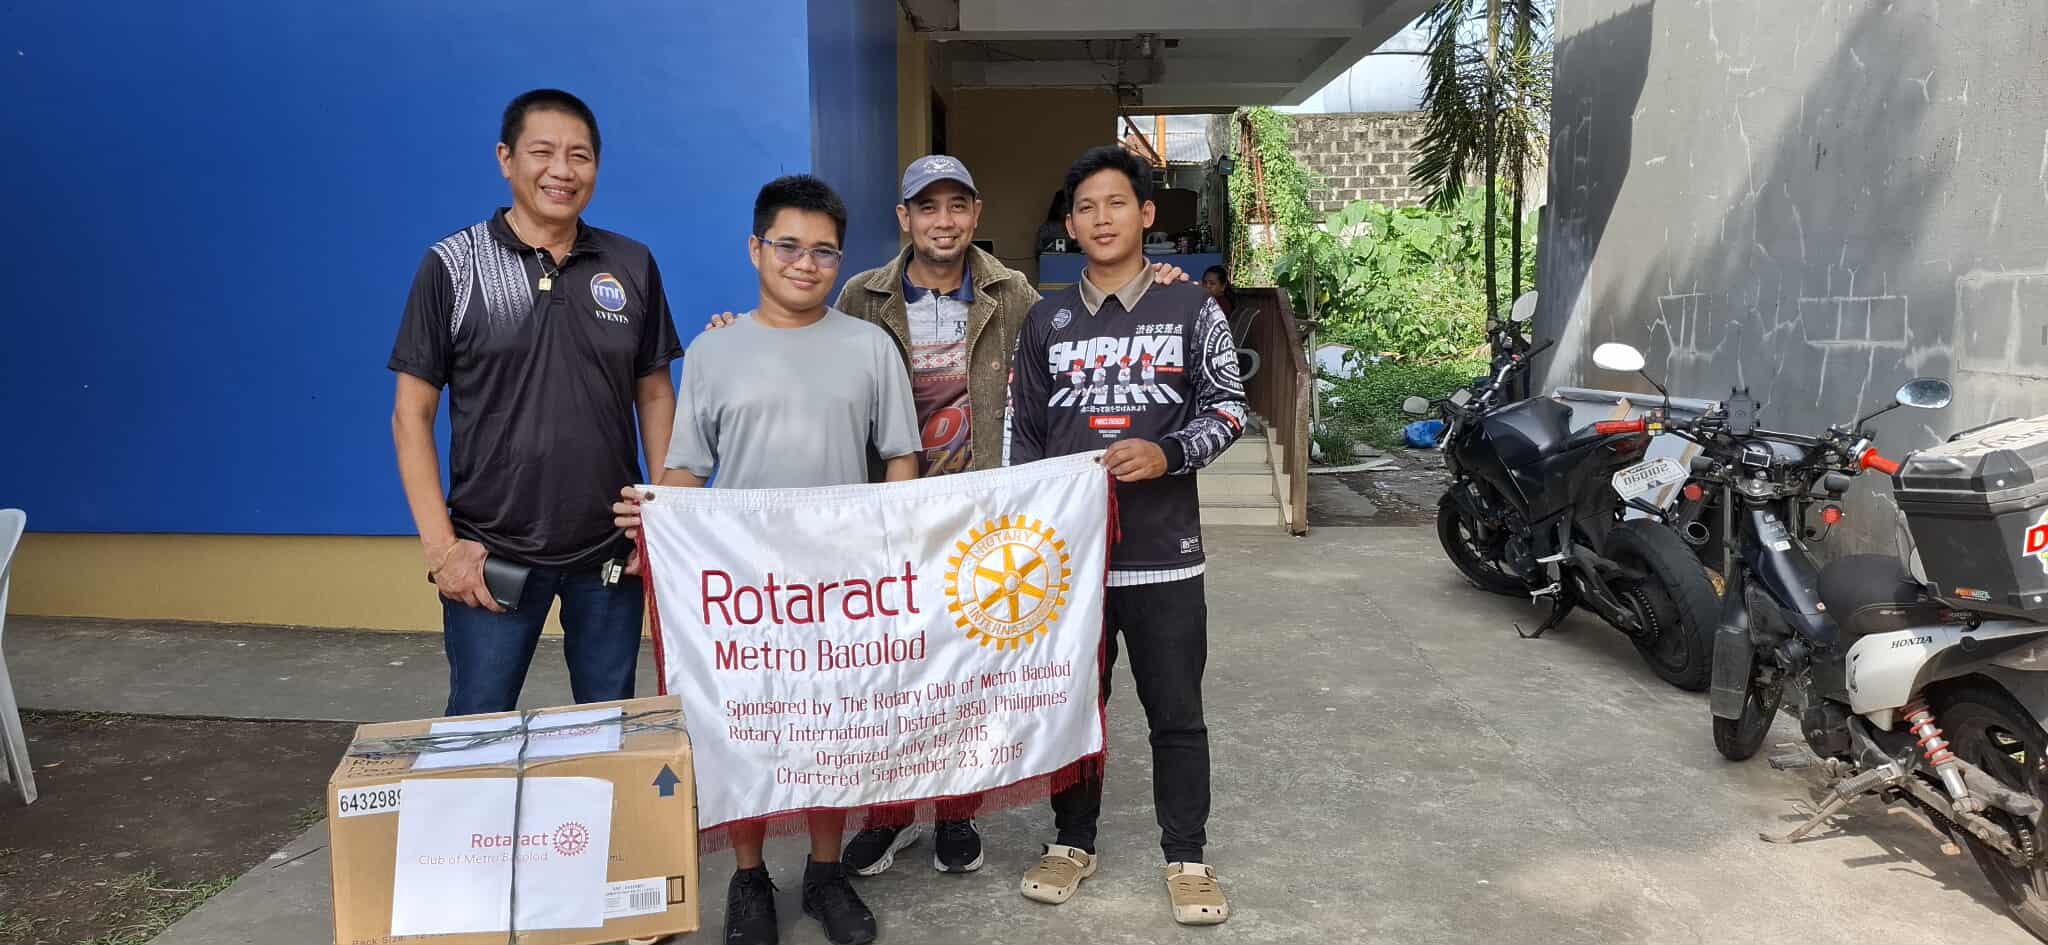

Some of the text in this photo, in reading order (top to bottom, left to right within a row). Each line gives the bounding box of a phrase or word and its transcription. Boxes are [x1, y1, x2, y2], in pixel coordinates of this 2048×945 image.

[1047, 335, 1184, 374] SHIBUYA
[701, 561, 920, 626] Rotaract
[966, 598, 1056, 637] INTERNAT
[715, 630, 925, 672] Metro Bacolod
[1891, 635, 1933, 649] HONDA
[726, 659, 1072, 721] Sponsored by The Rotary Club of Metro Bacolod
[728, 725, 782, 745] Rotary
[788, 719, 889, 743] International
[897, 708, 947, 735] District
[994, 690, 1068, 714] Philippines
[776, 741, 1024, 788] Chartered September 23, 2015
[816, 745, 889, 770] Organized
[896, 738, 927, 758] July
[957, 724, 988, 745] 2015
[418, 852, 549, 866] Club of Metro Bcolod
[471, 832, 549, 849] Rotaact
